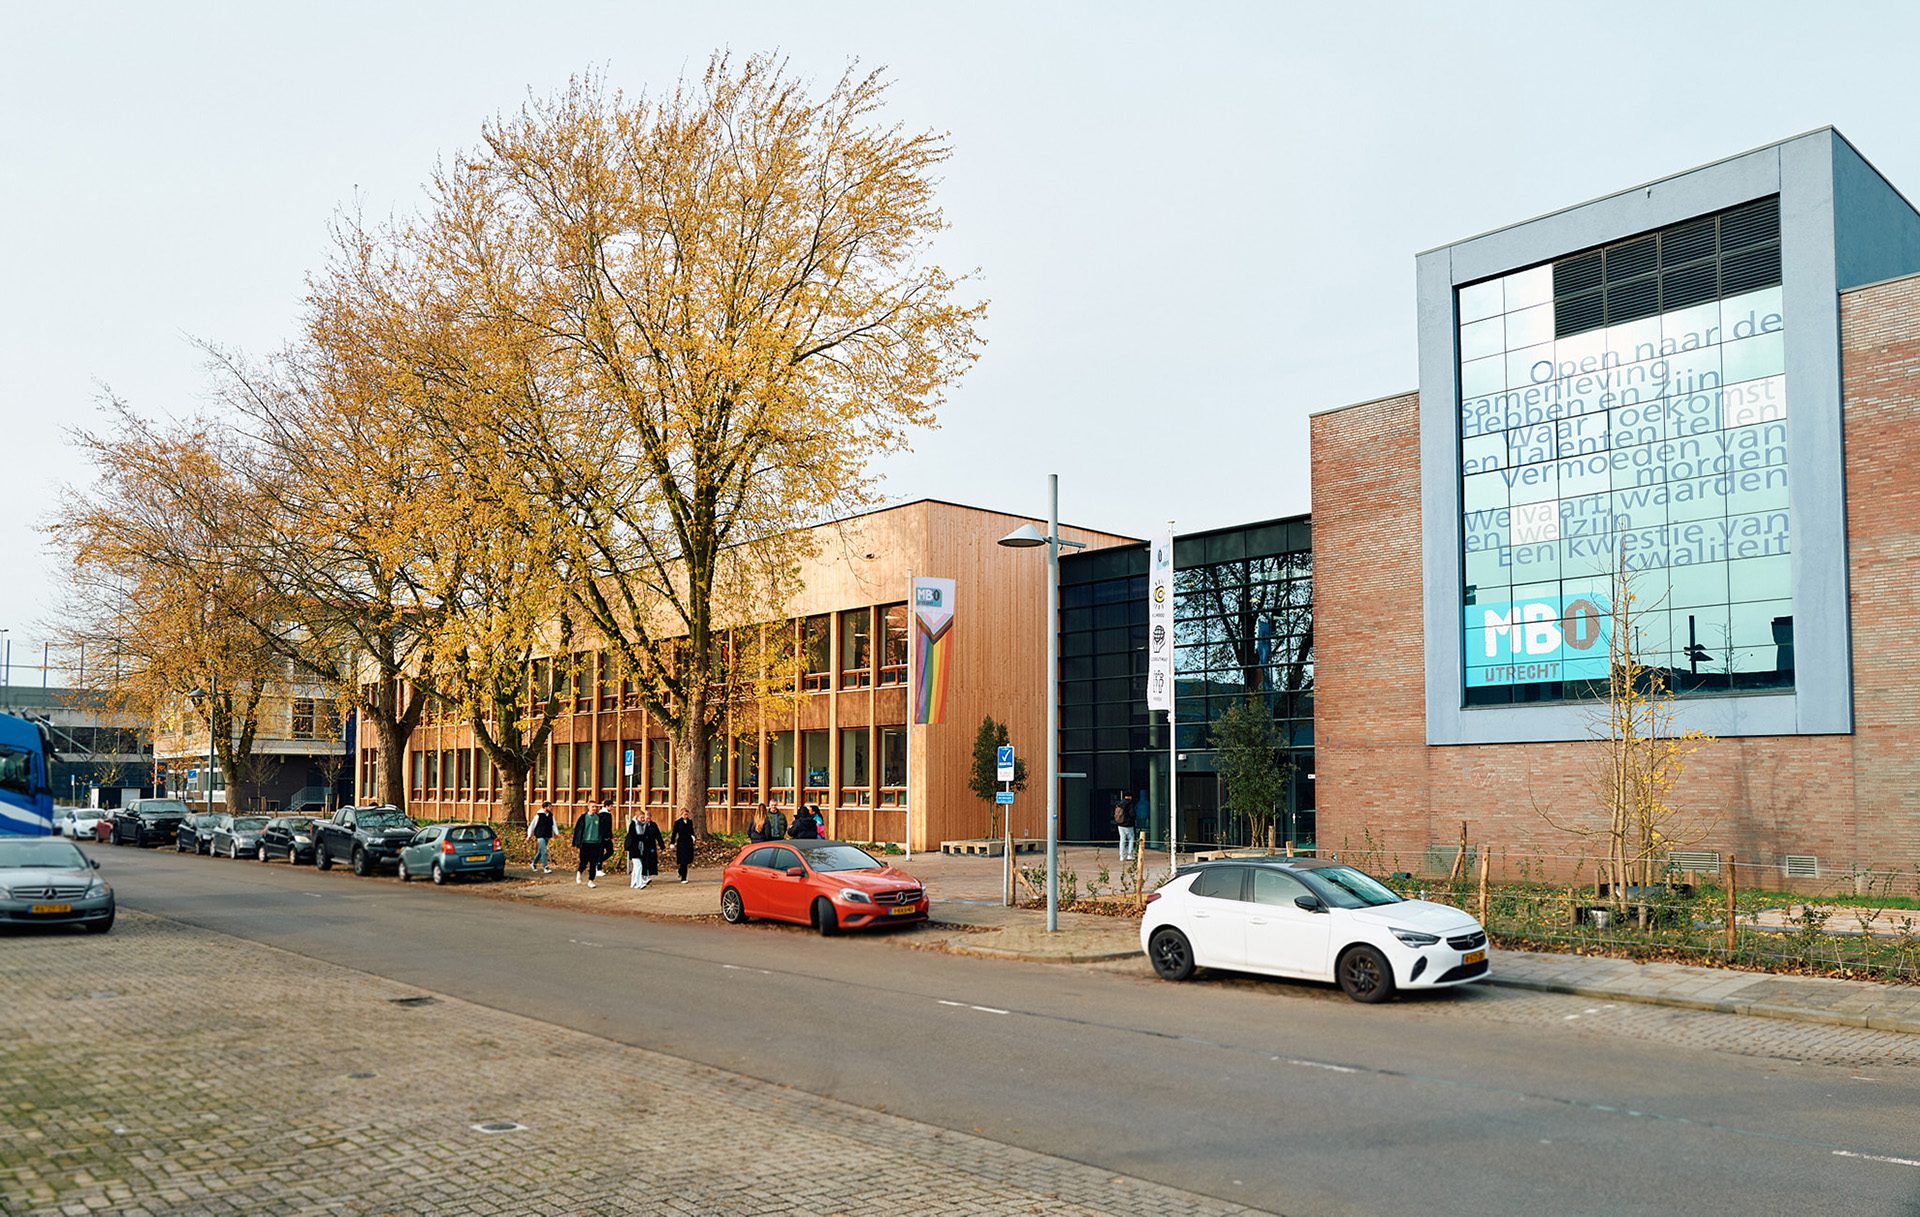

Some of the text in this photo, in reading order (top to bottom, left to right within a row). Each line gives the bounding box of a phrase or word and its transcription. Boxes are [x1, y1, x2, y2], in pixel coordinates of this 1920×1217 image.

[1530, 310, 1782, 384] Open naar de
[1463, 359, 1670, 419] samenleving
[1463, 368, 1720, 437] Hebben en zijn
[1463, 402, 1779, 475] en Talenten tellen
[1502, 417, 1588, 450] Waar
[1715, 423, 1787, 451] van
[1636, 445, 1788, 486] morgen
[1620, 467, 1788, 510] waarden
[1464, 511, 1632, 551] en welzijn
[1498, 511, 1790, 568] Een kwestie van
[1621, 530, 1790, 571] kwaliteit
[917, 588, 940, 601] MBO
[1484, 599, 1600, 657] MBO
[1485, 663, 1560, 681] UTRECHT
